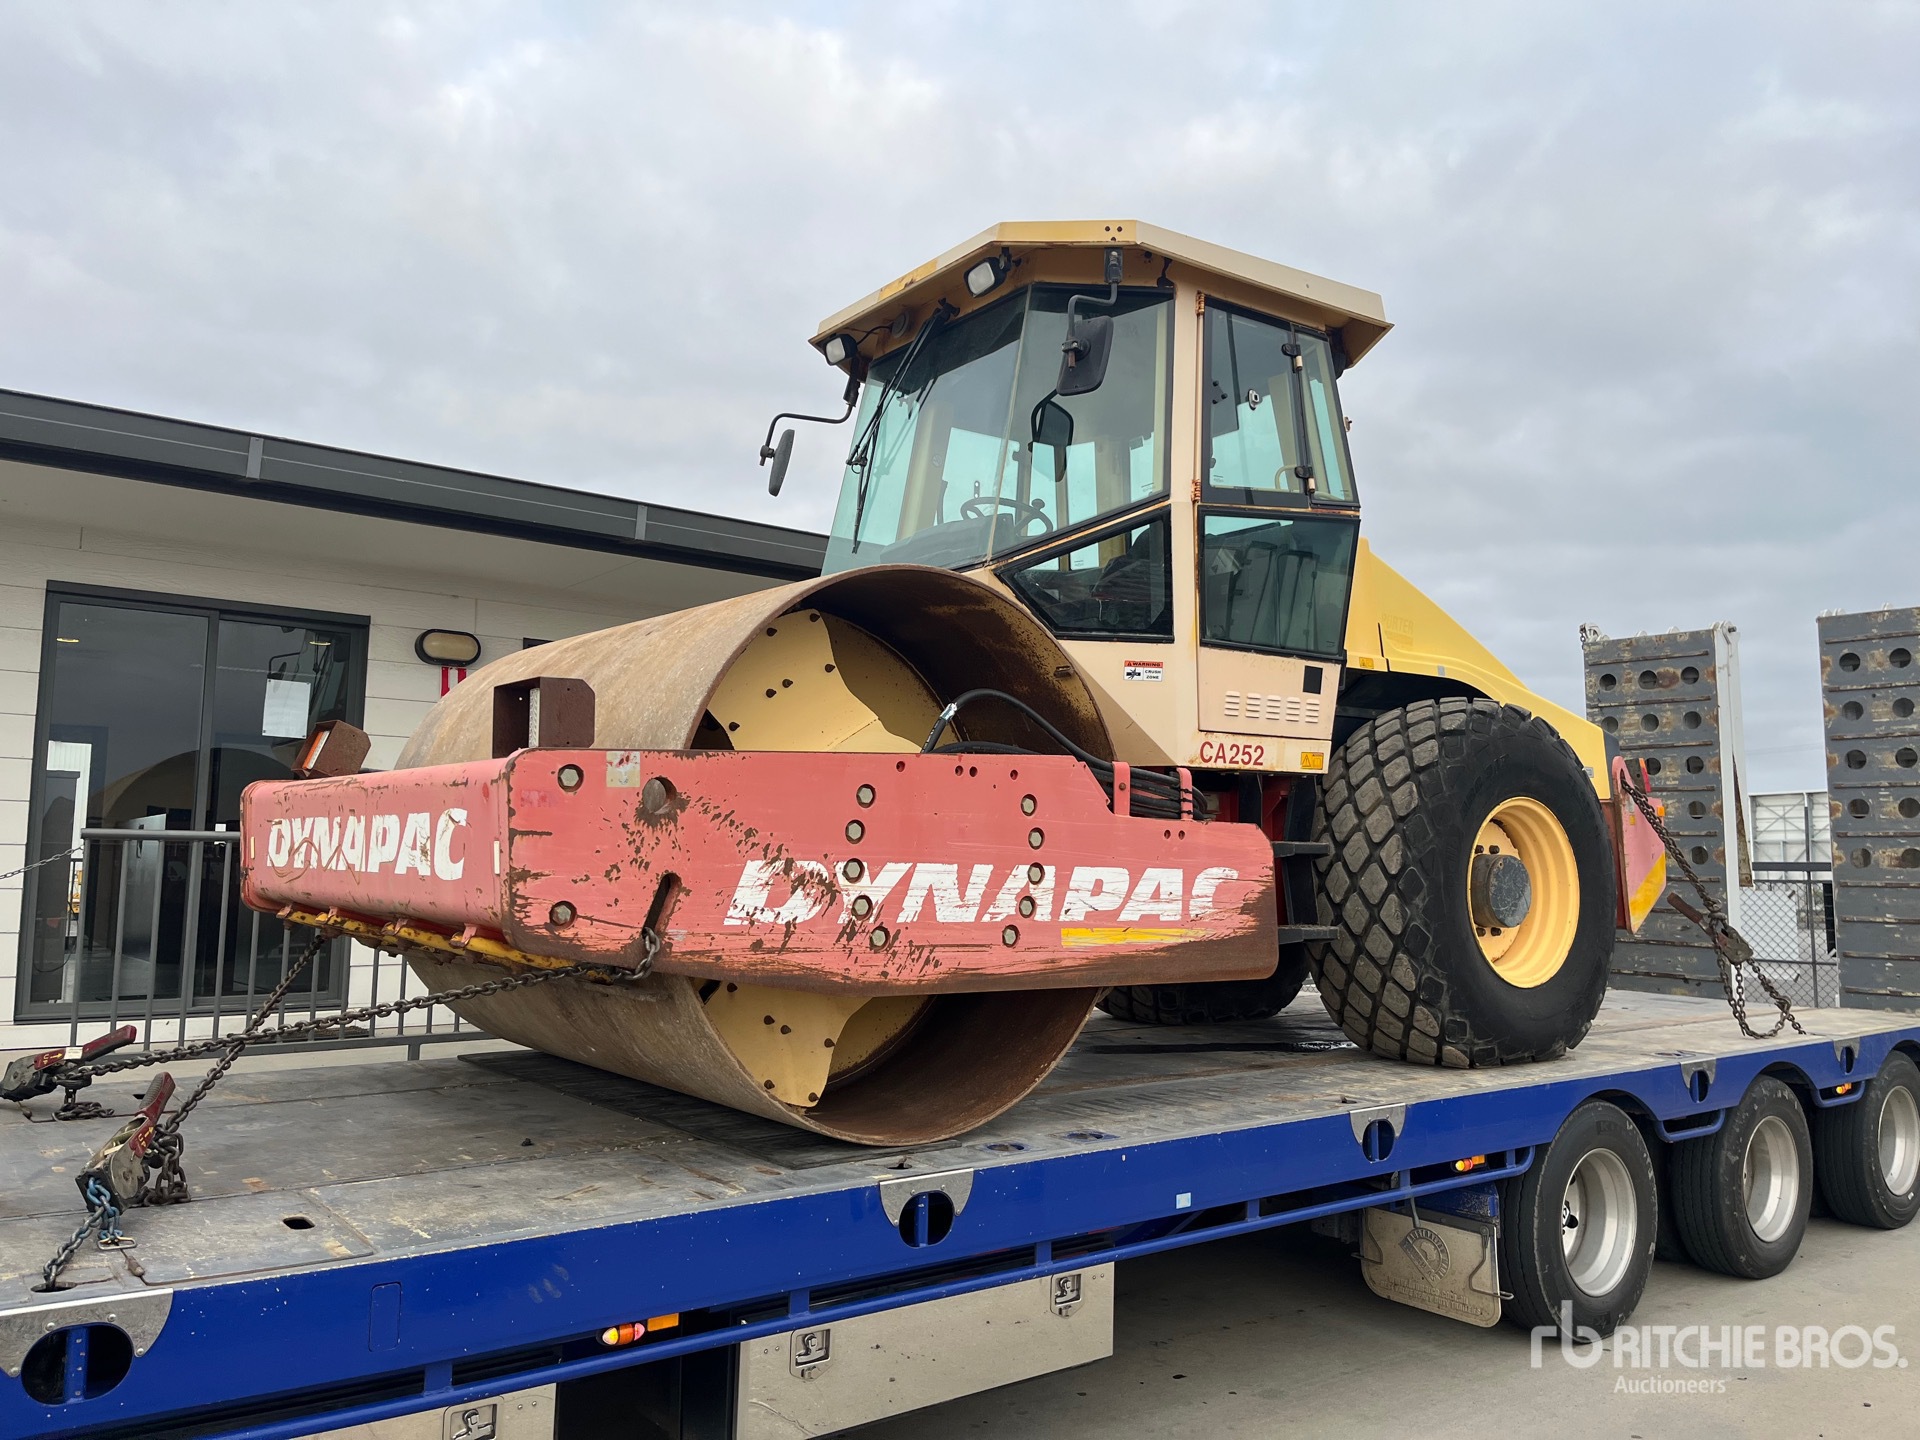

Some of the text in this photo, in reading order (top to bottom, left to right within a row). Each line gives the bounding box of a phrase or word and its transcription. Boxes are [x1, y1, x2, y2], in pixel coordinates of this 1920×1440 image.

[1200, 741, 1264, 766] CA252
[267, 808, 468, 881] DYNAPAC
[723, 860, 1240, 926] DYNAPAC
